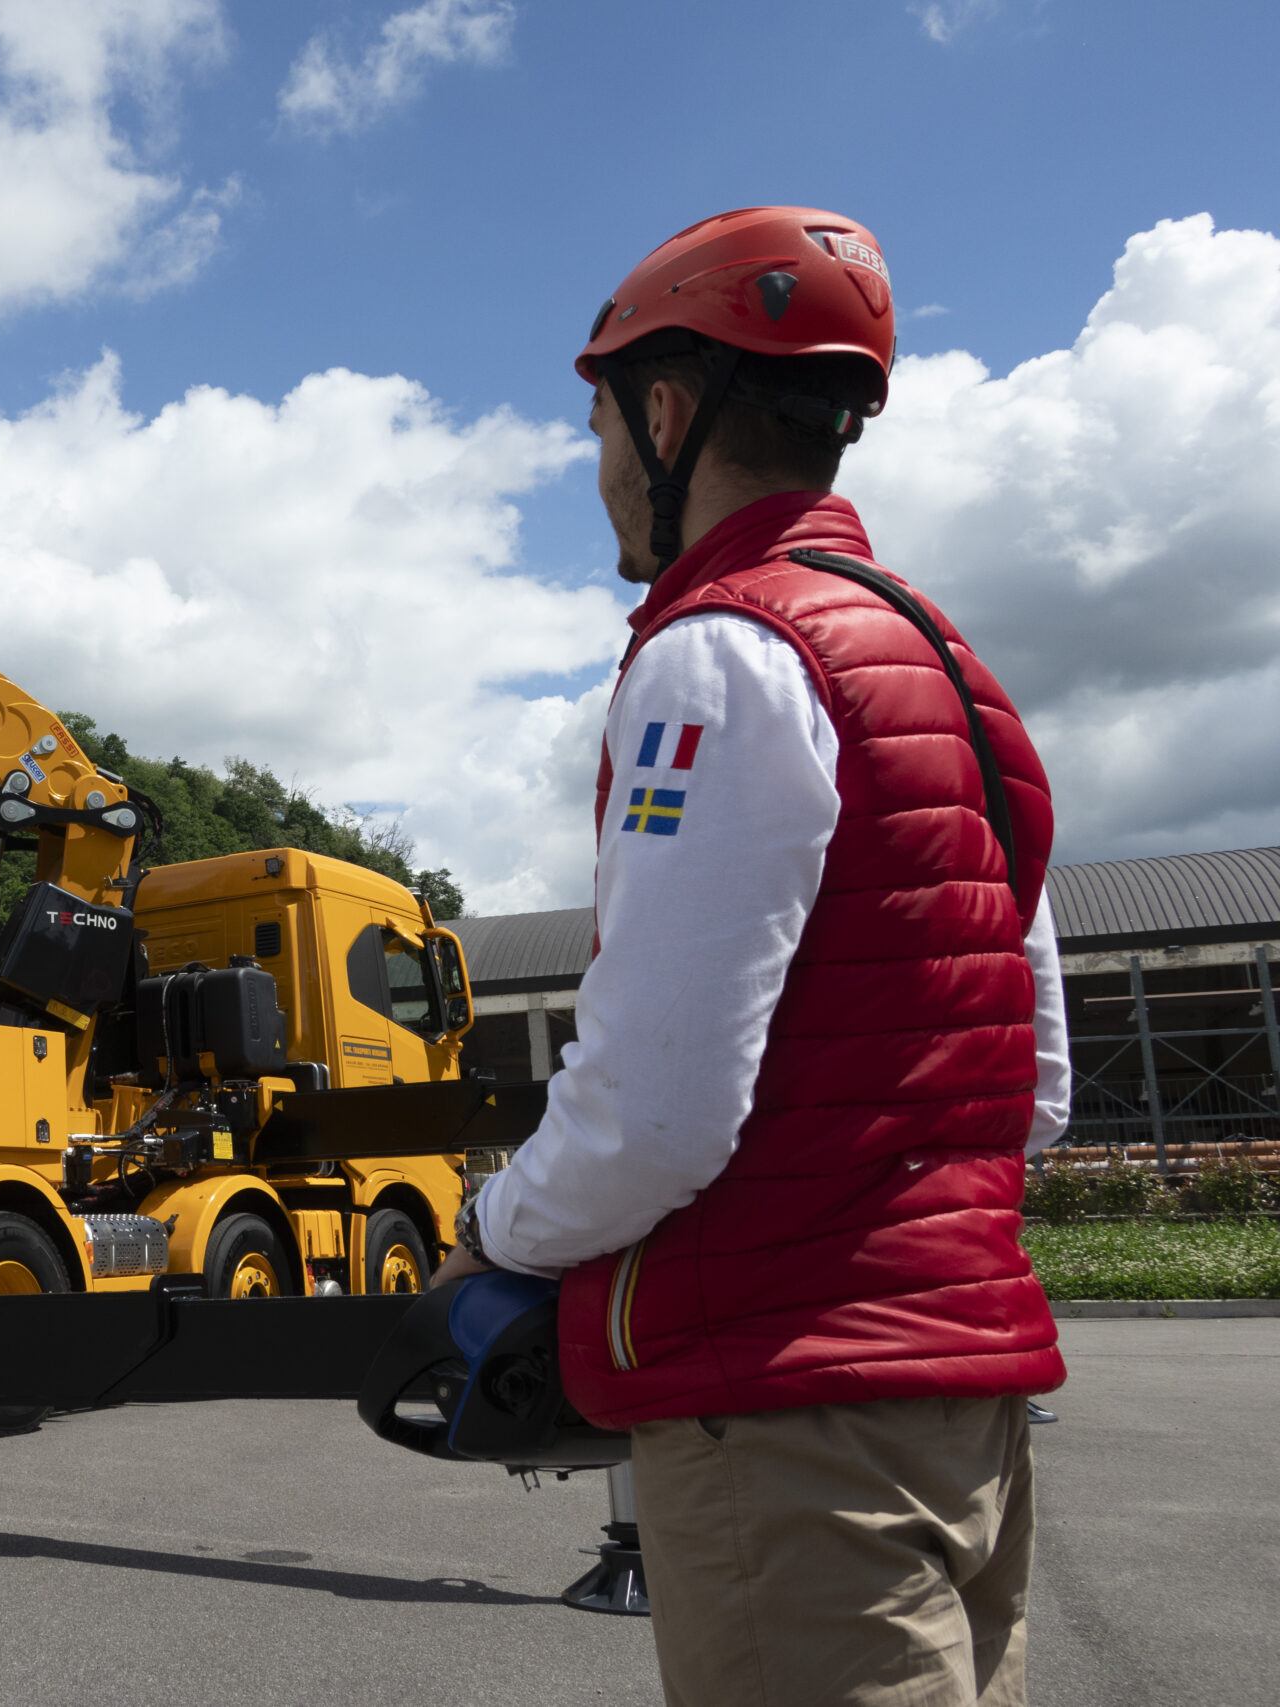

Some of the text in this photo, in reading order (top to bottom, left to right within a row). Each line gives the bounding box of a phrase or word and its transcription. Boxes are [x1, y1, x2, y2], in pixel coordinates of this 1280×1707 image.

[846, 244, 888, 275] FAS
[53, 725, 76, 756] FASSI
[46, 911, 117, 930] TECHNO
